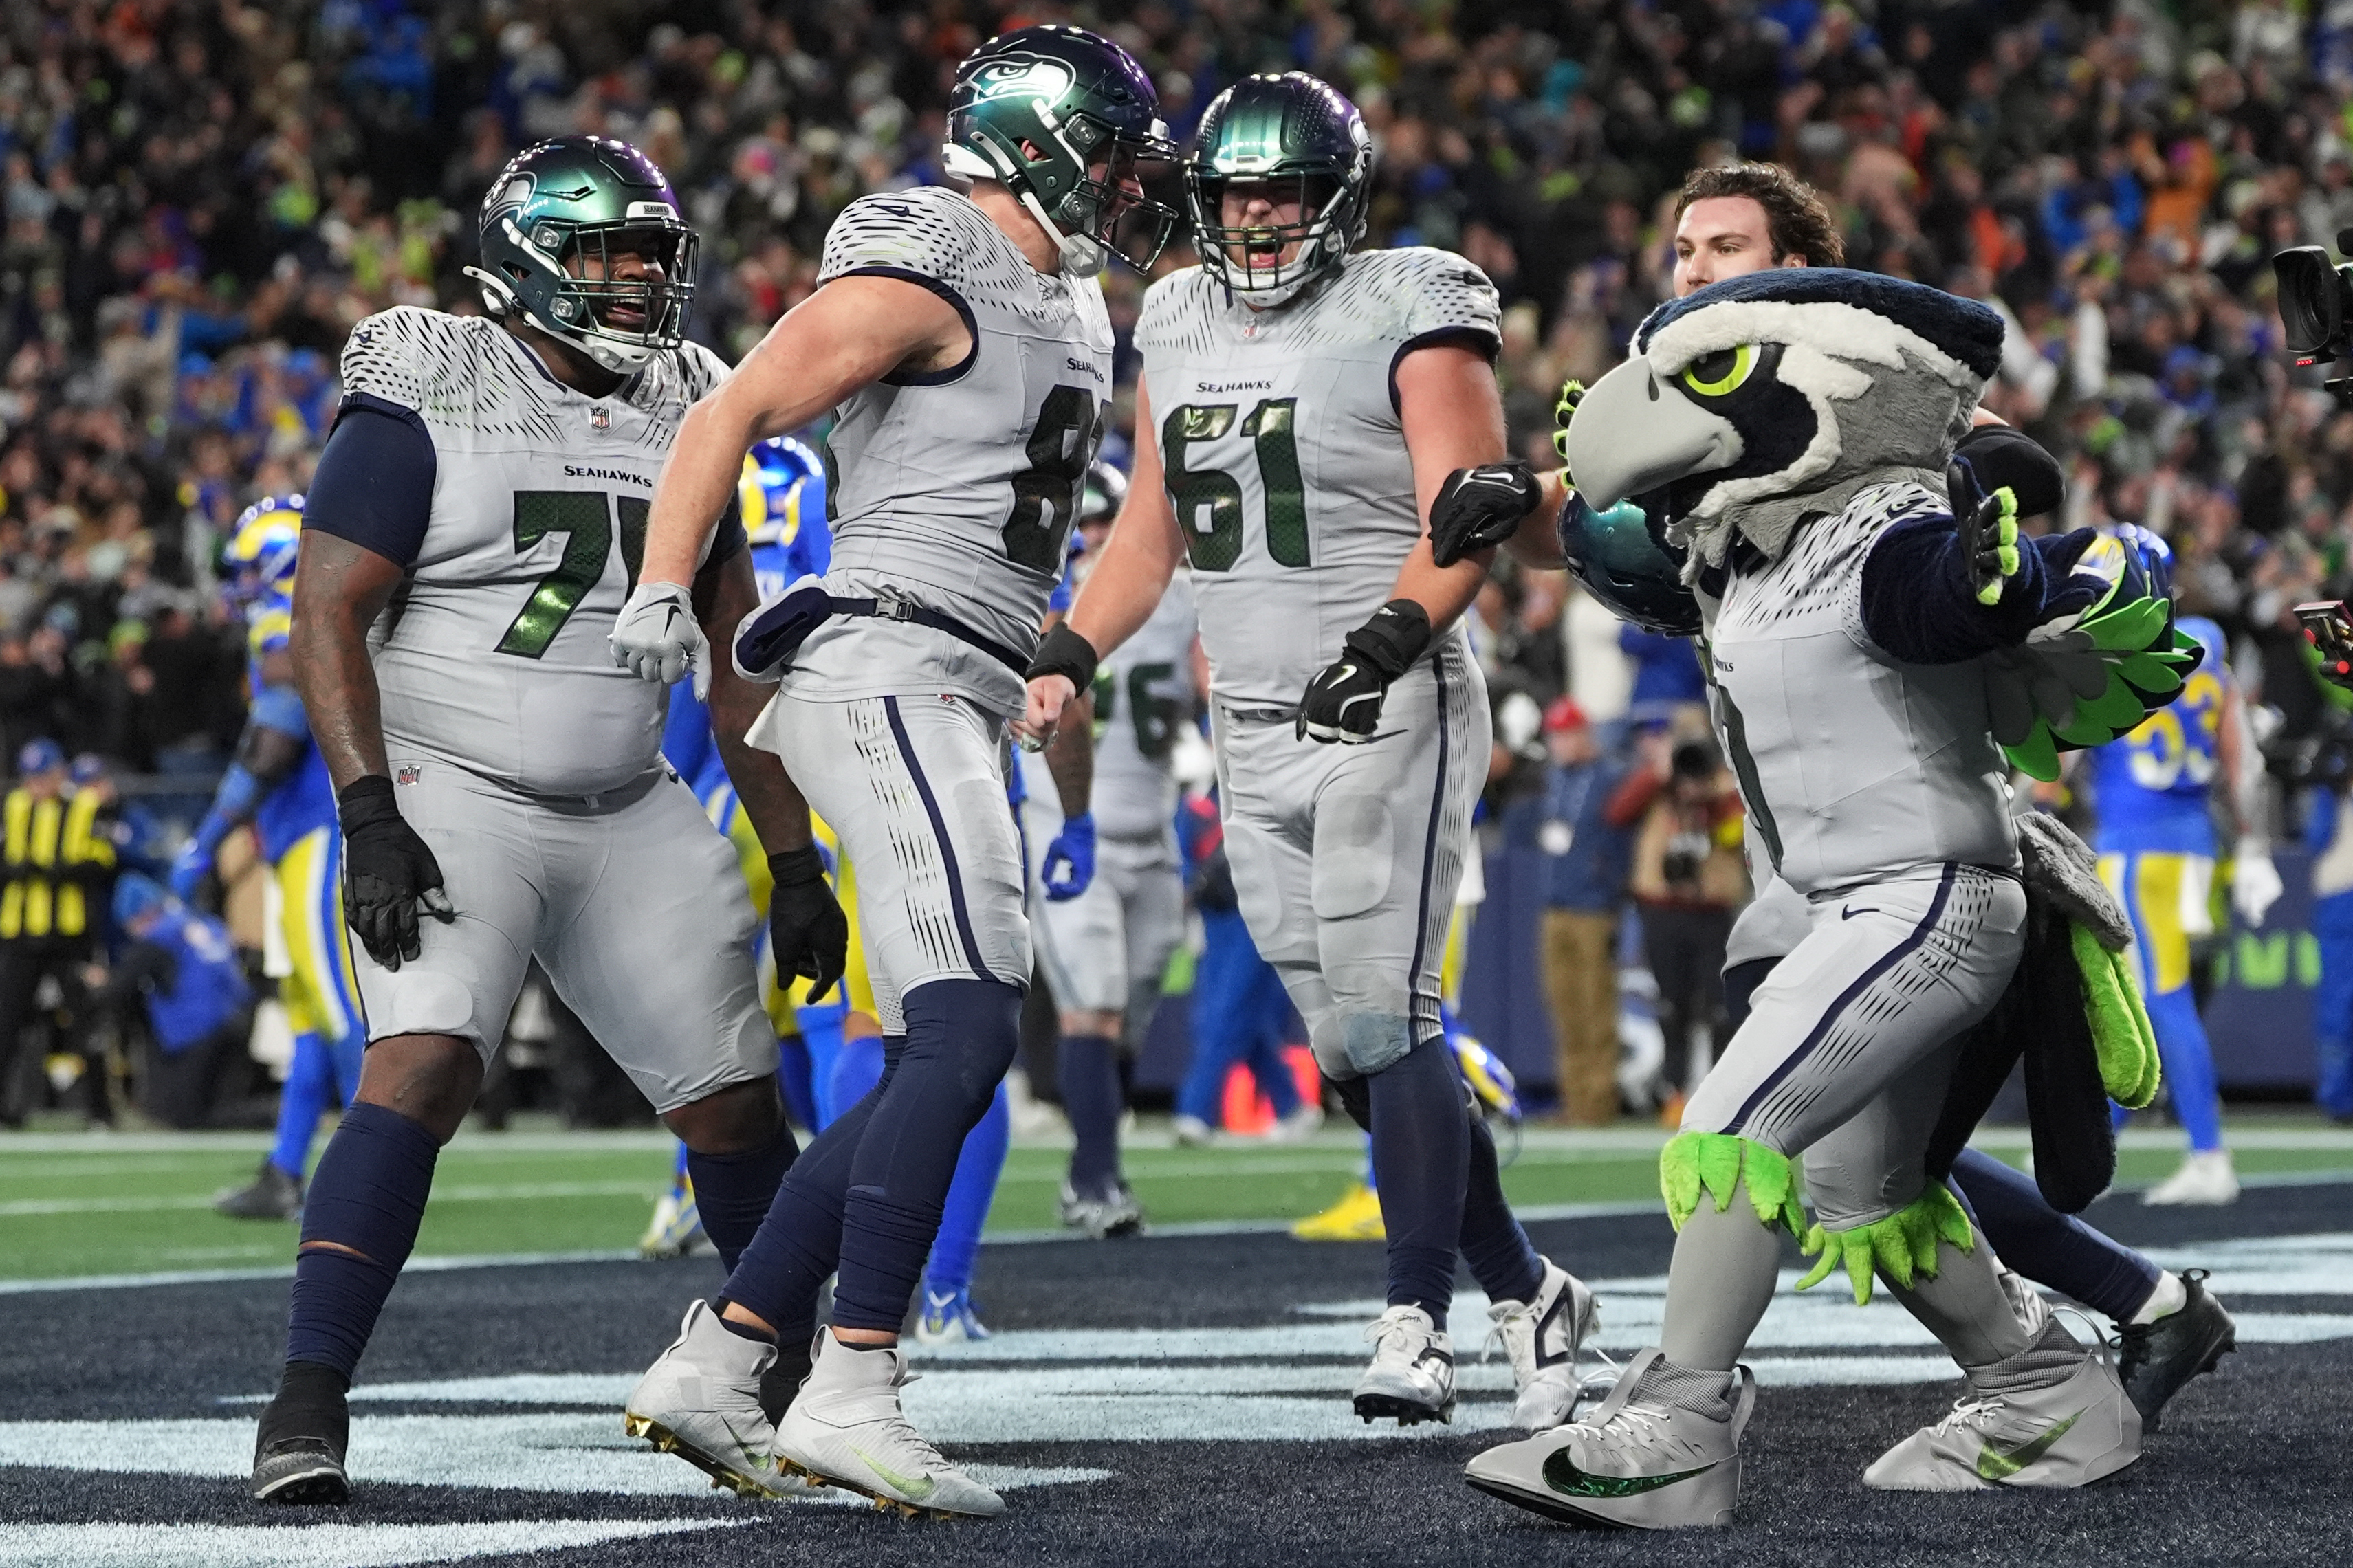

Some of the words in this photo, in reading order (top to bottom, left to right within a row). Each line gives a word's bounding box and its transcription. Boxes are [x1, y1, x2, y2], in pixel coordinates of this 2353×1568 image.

[1196, 381, 1273, 393] SEAHAWKS
[564, 465, 653, 488] SEAHAWKS
[1002, 384, 1113, 576] 8
[1163, 397, 1311, 572] 61
